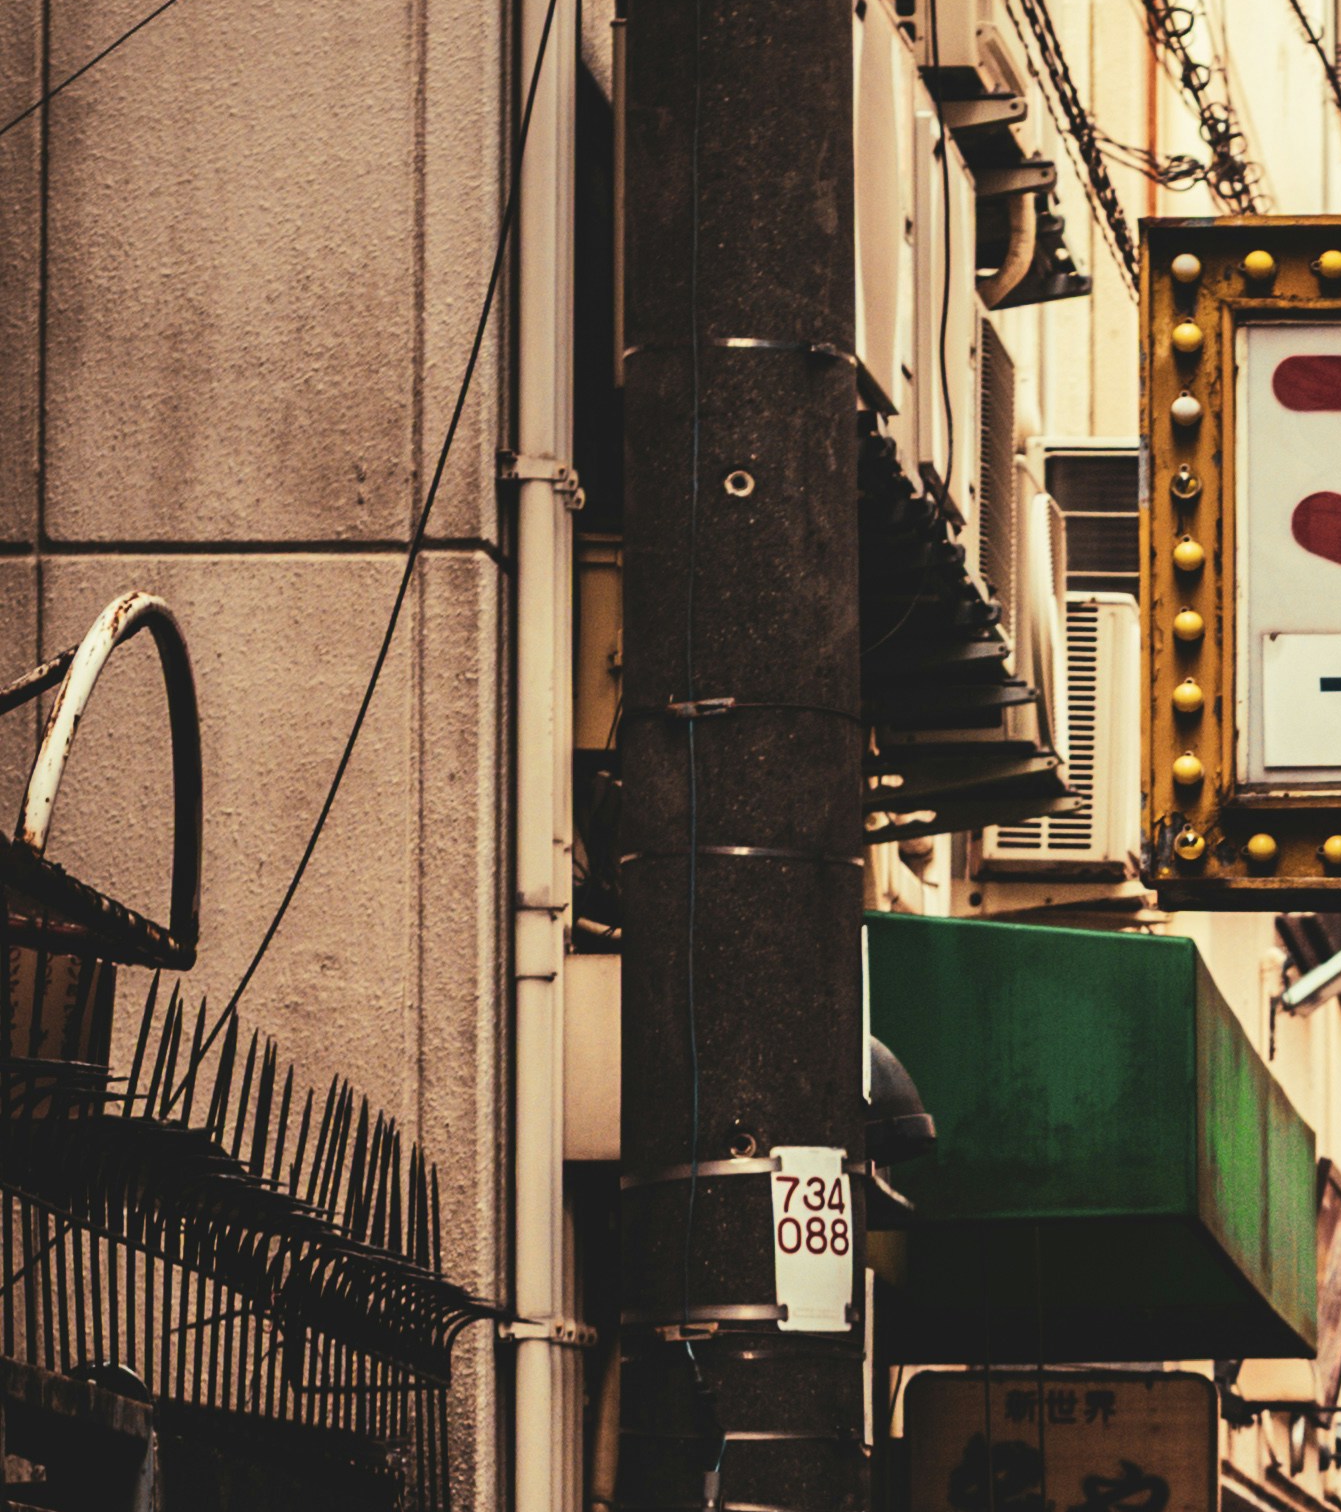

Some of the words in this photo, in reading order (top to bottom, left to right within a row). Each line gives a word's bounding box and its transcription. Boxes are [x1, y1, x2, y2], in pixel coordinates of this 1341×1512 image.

[776, 1176, 846, 1215] 734
[777, 1216, 850, 1256] 088
[1004, 1389, 1116, 1427] 新世界
